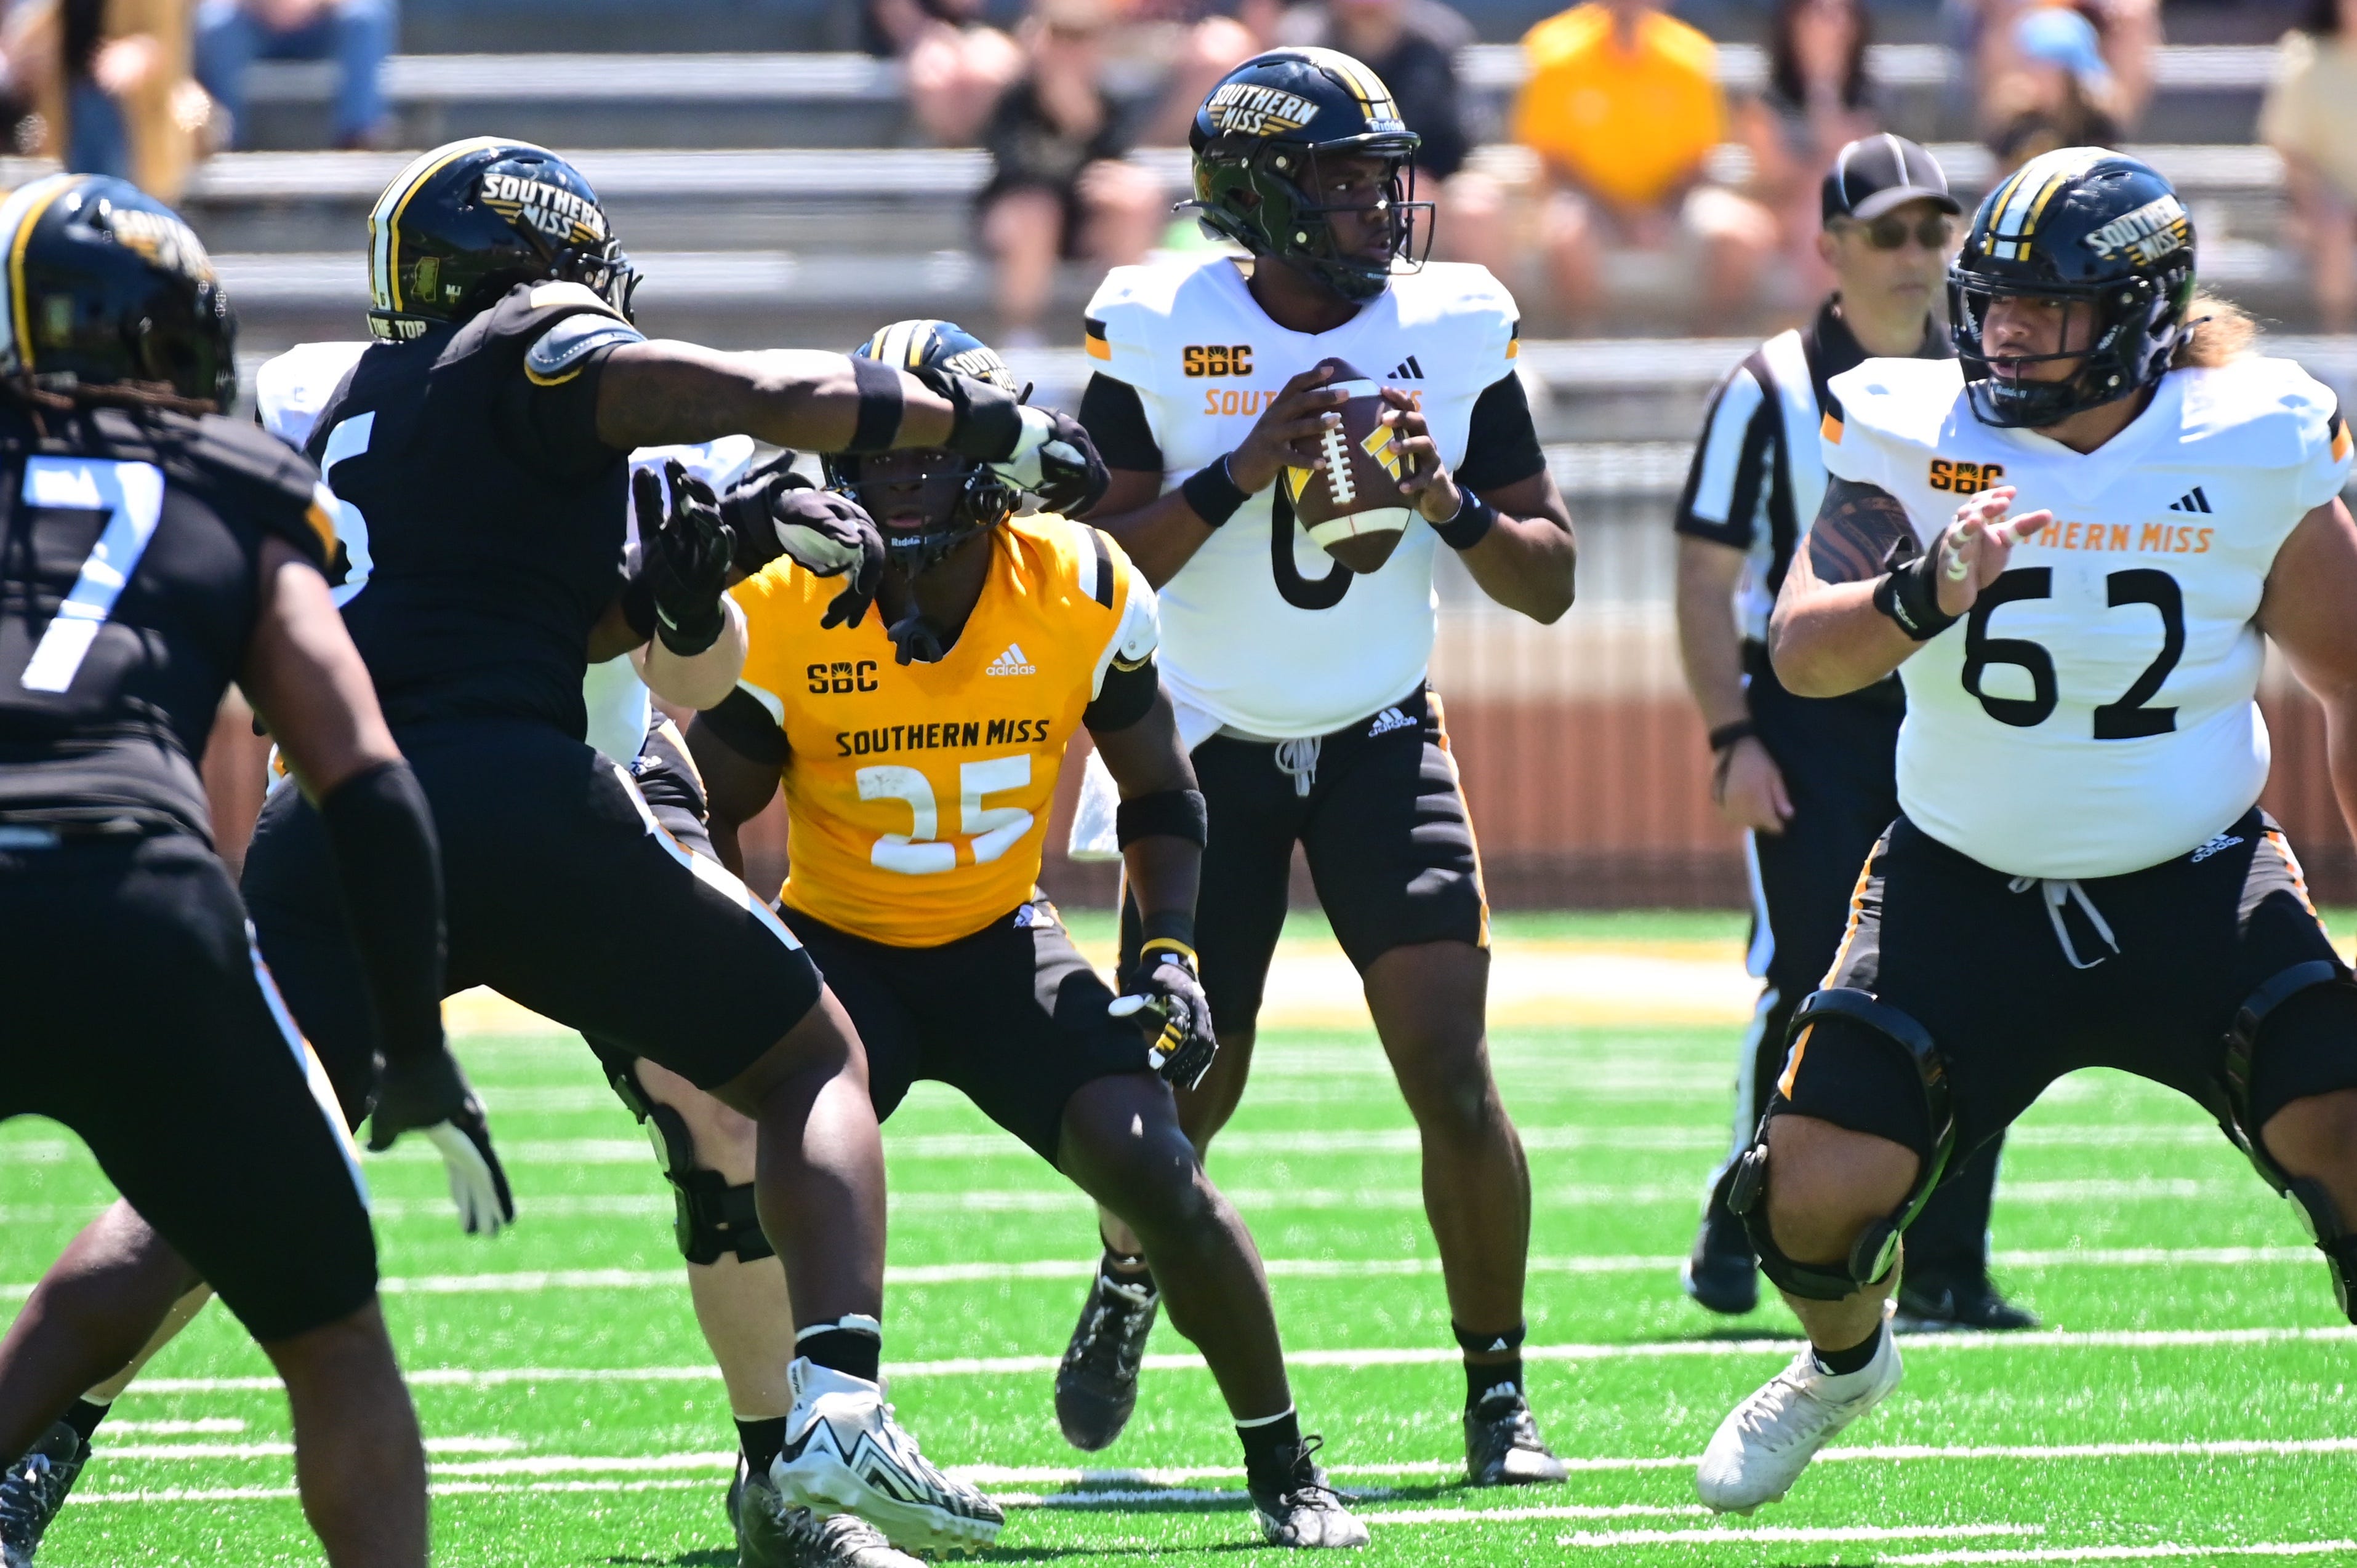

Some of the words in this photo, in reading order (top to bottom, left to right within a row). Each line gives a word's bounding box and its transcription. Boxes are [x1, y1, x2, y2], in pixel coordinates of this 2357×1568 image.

[1210, 84, 1320, 126] SOUTHERN
[1220, 106, 1266, 134] MISS
[481, 175, 606, 241] SOUTHERN
[523, 203, 574, 240] MISS
[371, 318, 392, 338] THE
[395, 320, 427, 339] TOP
[1183, 343, 1255, 378] SBC
[1204, 389, 1277, 415] SOUT
[1929, 458, 2006, 494] SBC
[2022, 521, 2133, 551] HERN
[2139, 523, 2215, 554] MISS
[20, 455, 165, 693] 7
[986, 663, 1036, 676] adidas
[1961, 566, 2186, 740] 62
[806, 659, 879, 694] SBC
[836, 722, 980, 757] SOUTHERN
[986, 719, 1050, 746] MISS
[1368, 716, 1417, 738] adidas
[855, 753, 1034, 874] 25
[2191, 836, 2245, 863] adidas
